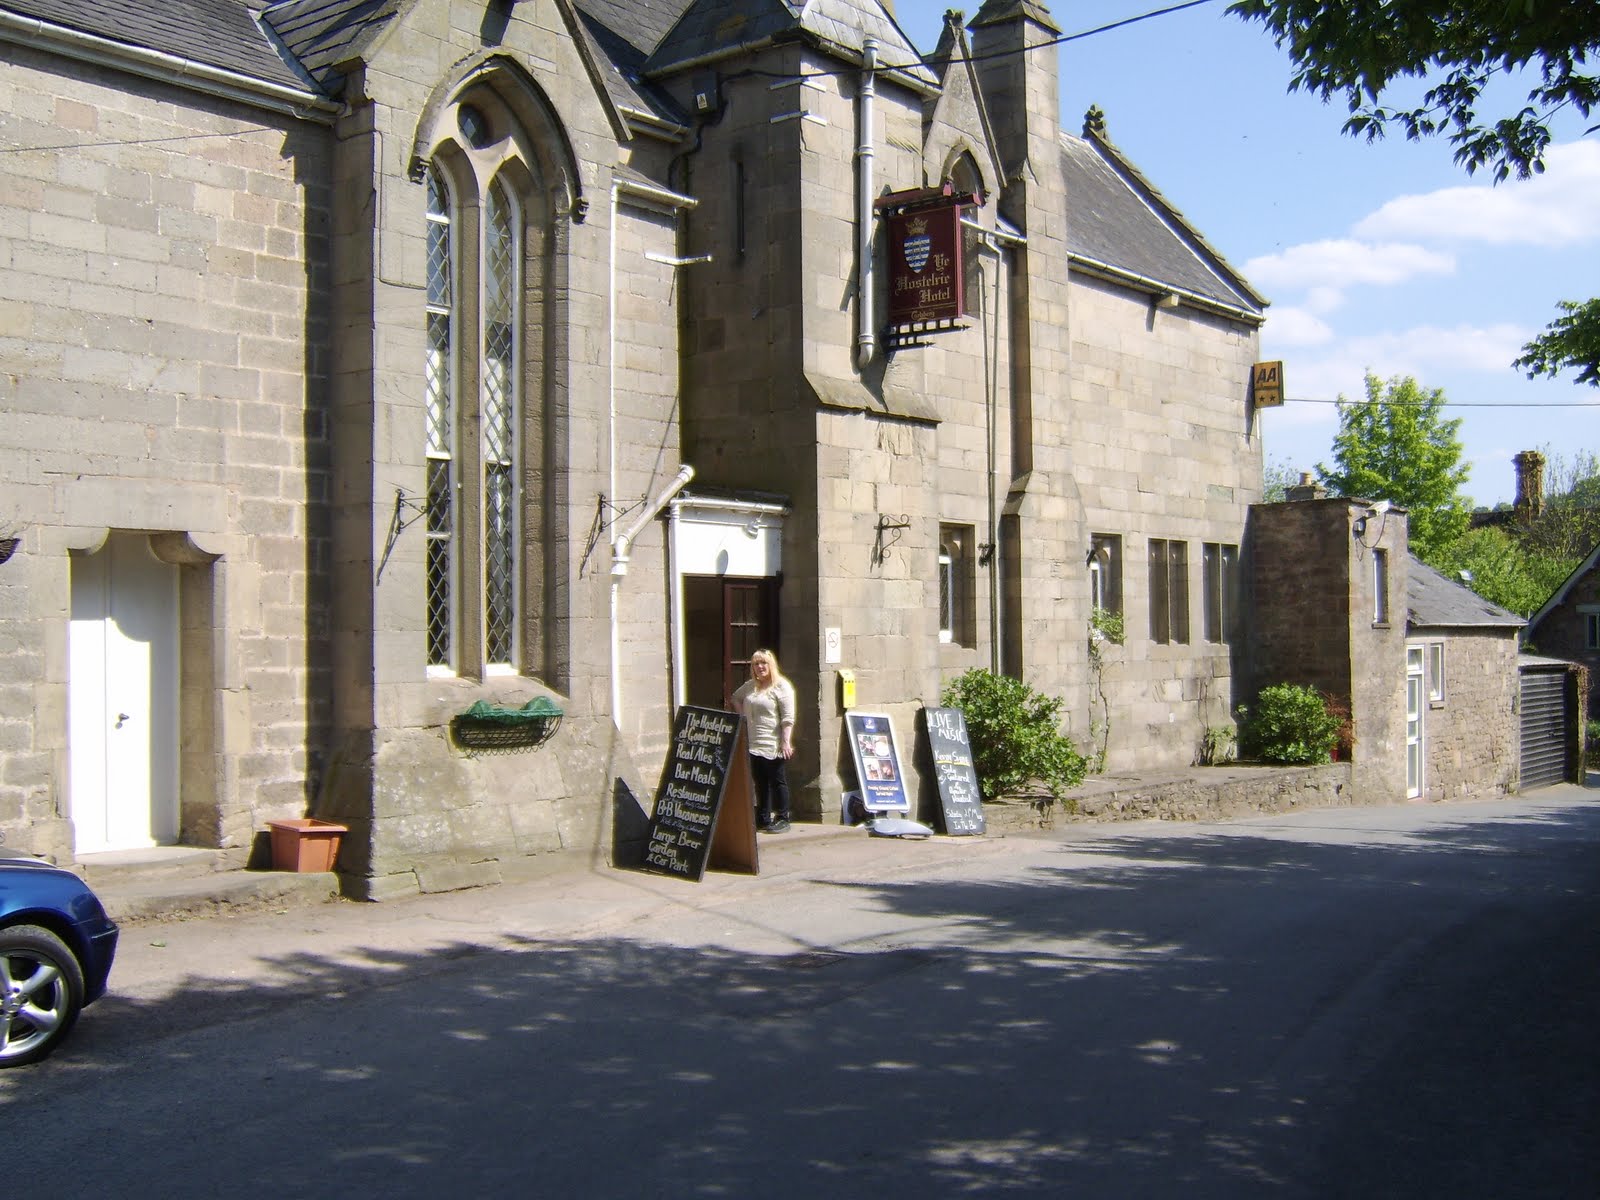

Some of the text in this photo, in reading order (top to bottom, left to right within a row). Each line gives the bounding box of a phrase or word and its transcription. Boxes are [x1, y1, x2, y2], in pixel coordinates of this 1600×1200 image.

[933, 253, 950, 271] Ye
[895, 273, 950, 296] Hostelrie
[919, 287, 950, 308] Hotel
[1256, 367, 1276, 384] AA
[684, 712, 700, 732] The
[929, 710, 953, 730] LIVE
[687, 726, 722, 745] Goodrich
[938, 728, 967, 745] MUSIC
[676, 743, 693, 760] Real
[693, 746, 713, 765] Ales
[674, 763, 717, 786] Bar Meals
[666, 782, 710, 804] Restaurant
[674, 802, 710, 826] Vacancies
[652, 825, 702, 850] Large Beer
[648, 840, 678, 858] Garden
[653, 854, 669, 866] Car
[669, 857, 690, 874] Park
